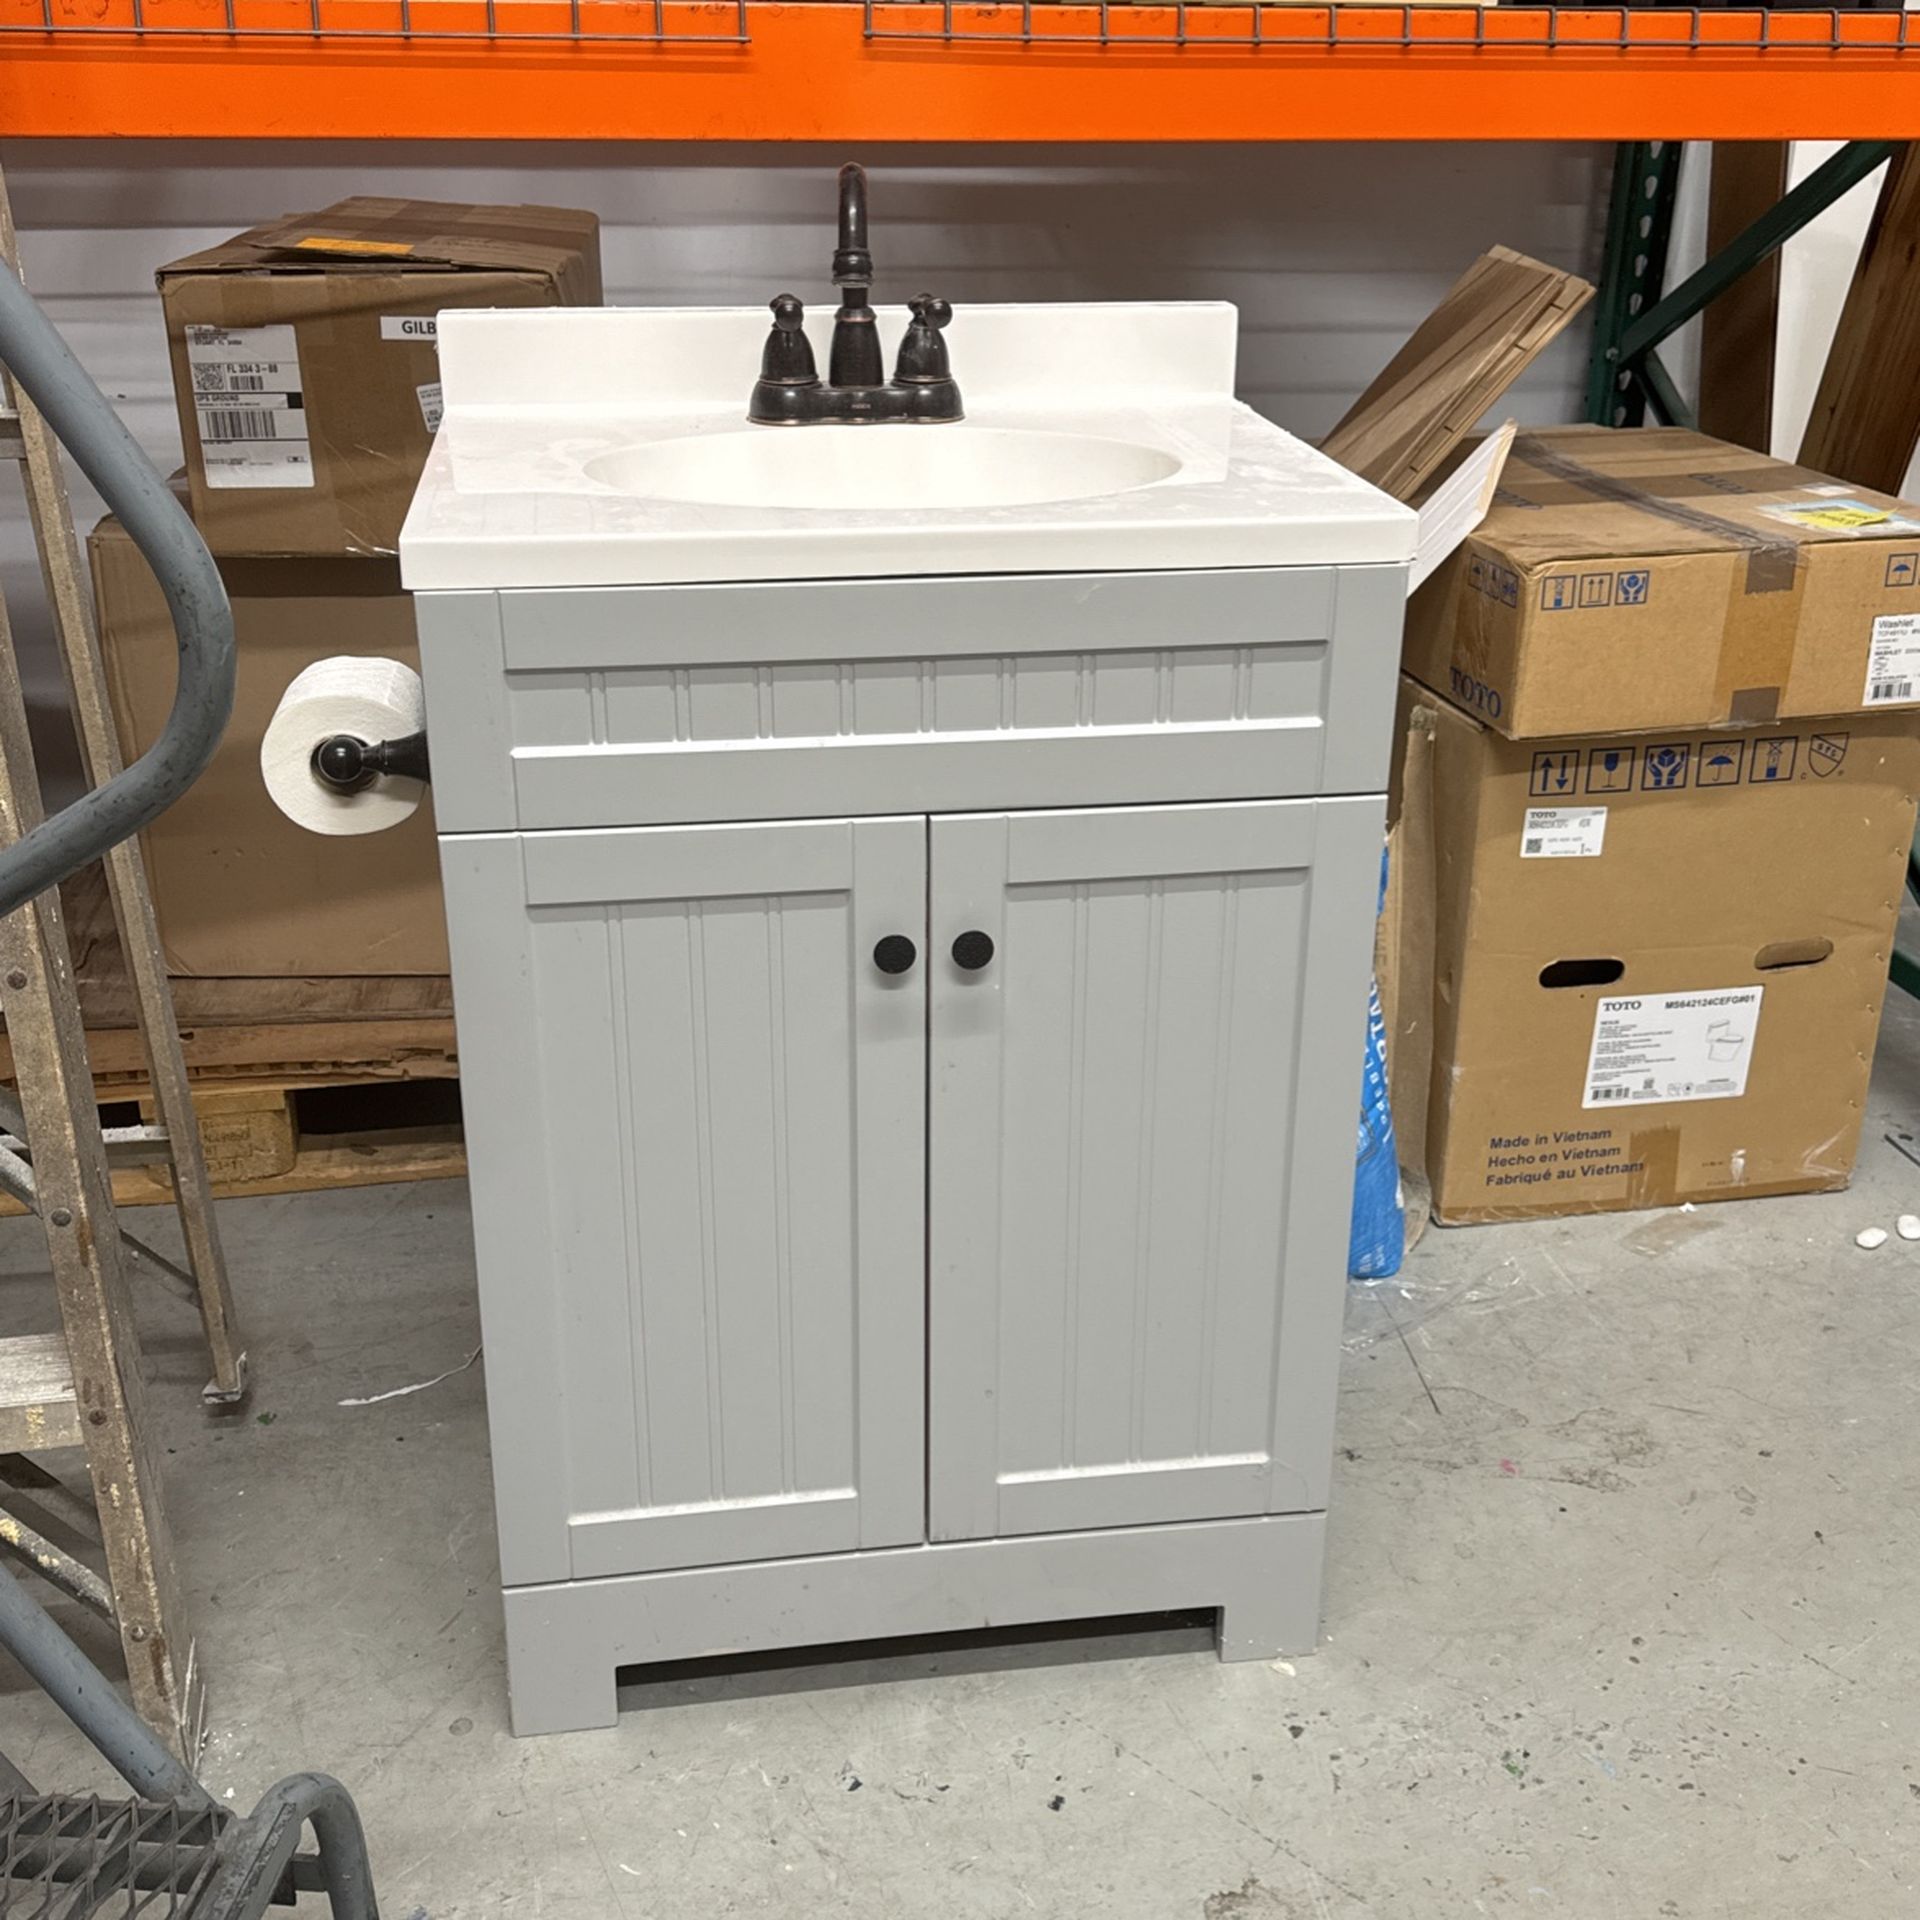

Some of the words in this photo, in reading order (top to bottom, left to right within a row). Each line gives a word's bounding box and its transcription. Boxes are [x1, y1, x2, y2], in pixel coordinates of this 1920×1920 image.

[1450, 666, 1502, 718] TOTO
[1530, 811, 1557, 819] TOTO
[1602, 1001, 1642, 1012] TOTO
[1490, 1135, 1530, 1149] Made
[1535, 1133, 1548, 1145] in
[1553, 1130, 1611, 1143] Vietnam
[1488, 1154, 1535, 1168] Hecho
[1539, 1153, 1557, 1162] en
[1562, 1147, 1621, 1161] Vietnam
[1486, 1168, 1552, 1186] Fabriqué
[1557, 1169, 1575, 1179] au
[1581, 1162, 1644, 1177] Vietnam
